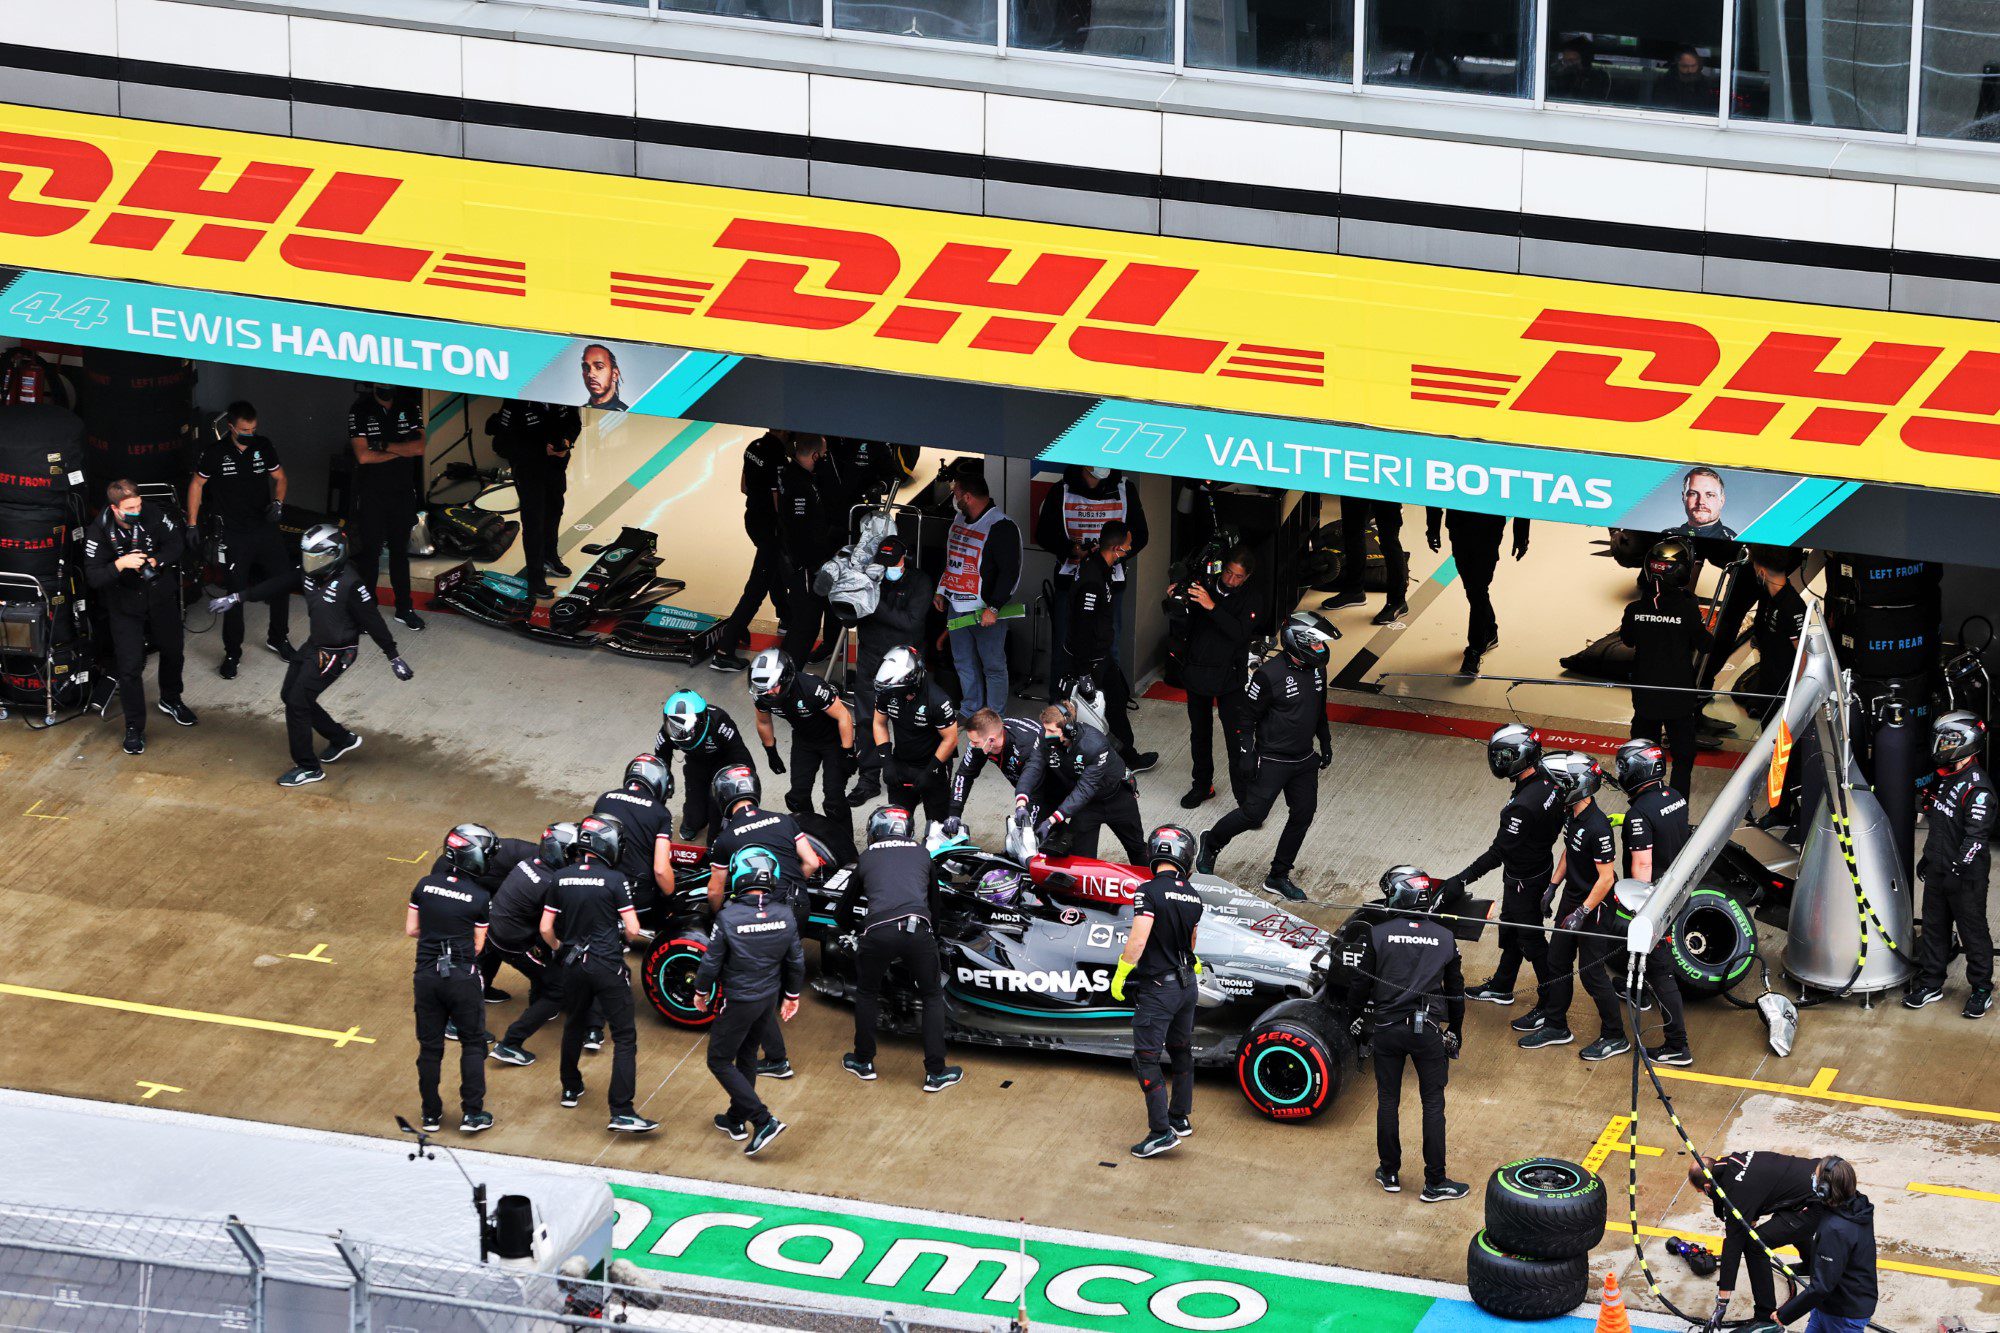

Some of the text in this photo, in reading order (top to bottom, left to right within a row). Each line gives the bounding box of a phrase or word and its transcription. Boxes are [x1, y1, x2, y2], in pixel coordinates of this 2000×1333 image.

[0, 131, 435, 283] DHL
[704, 217, 1229, 374] DHL
[10, 291, 509, 381] 44 LEWIS HAMILTON
[1509, 308, 2000, 459] DHL
[745, 450, 765, 467] TRONAS
[1095, 417, 1613, 509] 77 VALTTERI BOTTAS
[0, 473, 53, 488] EFT FRONT
[0, 538, 54, 550] EFT REAR
[1869, 562, 1924, 580] LEFT FRONT
[661, 607, 698, 618] PETRONAS
[1634, 614, 1682, 625] PETRONAS
[1869, 635, 1923, 651] LEFT REAR
[1546, 735, 1586, 745] LANE
[606, 792, 653, 807] PETRONAS
[733, 815, 781, 837] PETRONAS
[869, 839, 918, 850] PETRONAS
[673, 850, 697, 859] INEOS
[517, 860, 542, 884] TRONAS
[558, 877, 605, 887] PETRONAS
[1082, 874, 1139, 899] INEO
[423, 885, 473, 902] PETRONAS
[1165, 891, 1201, 904] PETRONA
[1215, 886, 1253, 898] AMG
[990, 912, 1013, 922] AMD
[1729, 898, 1754, 938] PIRELLI
[736, 920, 787, 934] PETRONAS
[1250, 914, 1319, 950] 44
[1117, 932, 1129, 944] Te
[1387, 935, 1439, 946] PETRONAS
[957, 966, 1111, 994] PETRONAS
[1244, 1031, 1309, 1056] P ZERO
[1272, 1106, 1312, 1117] PIRELLI
